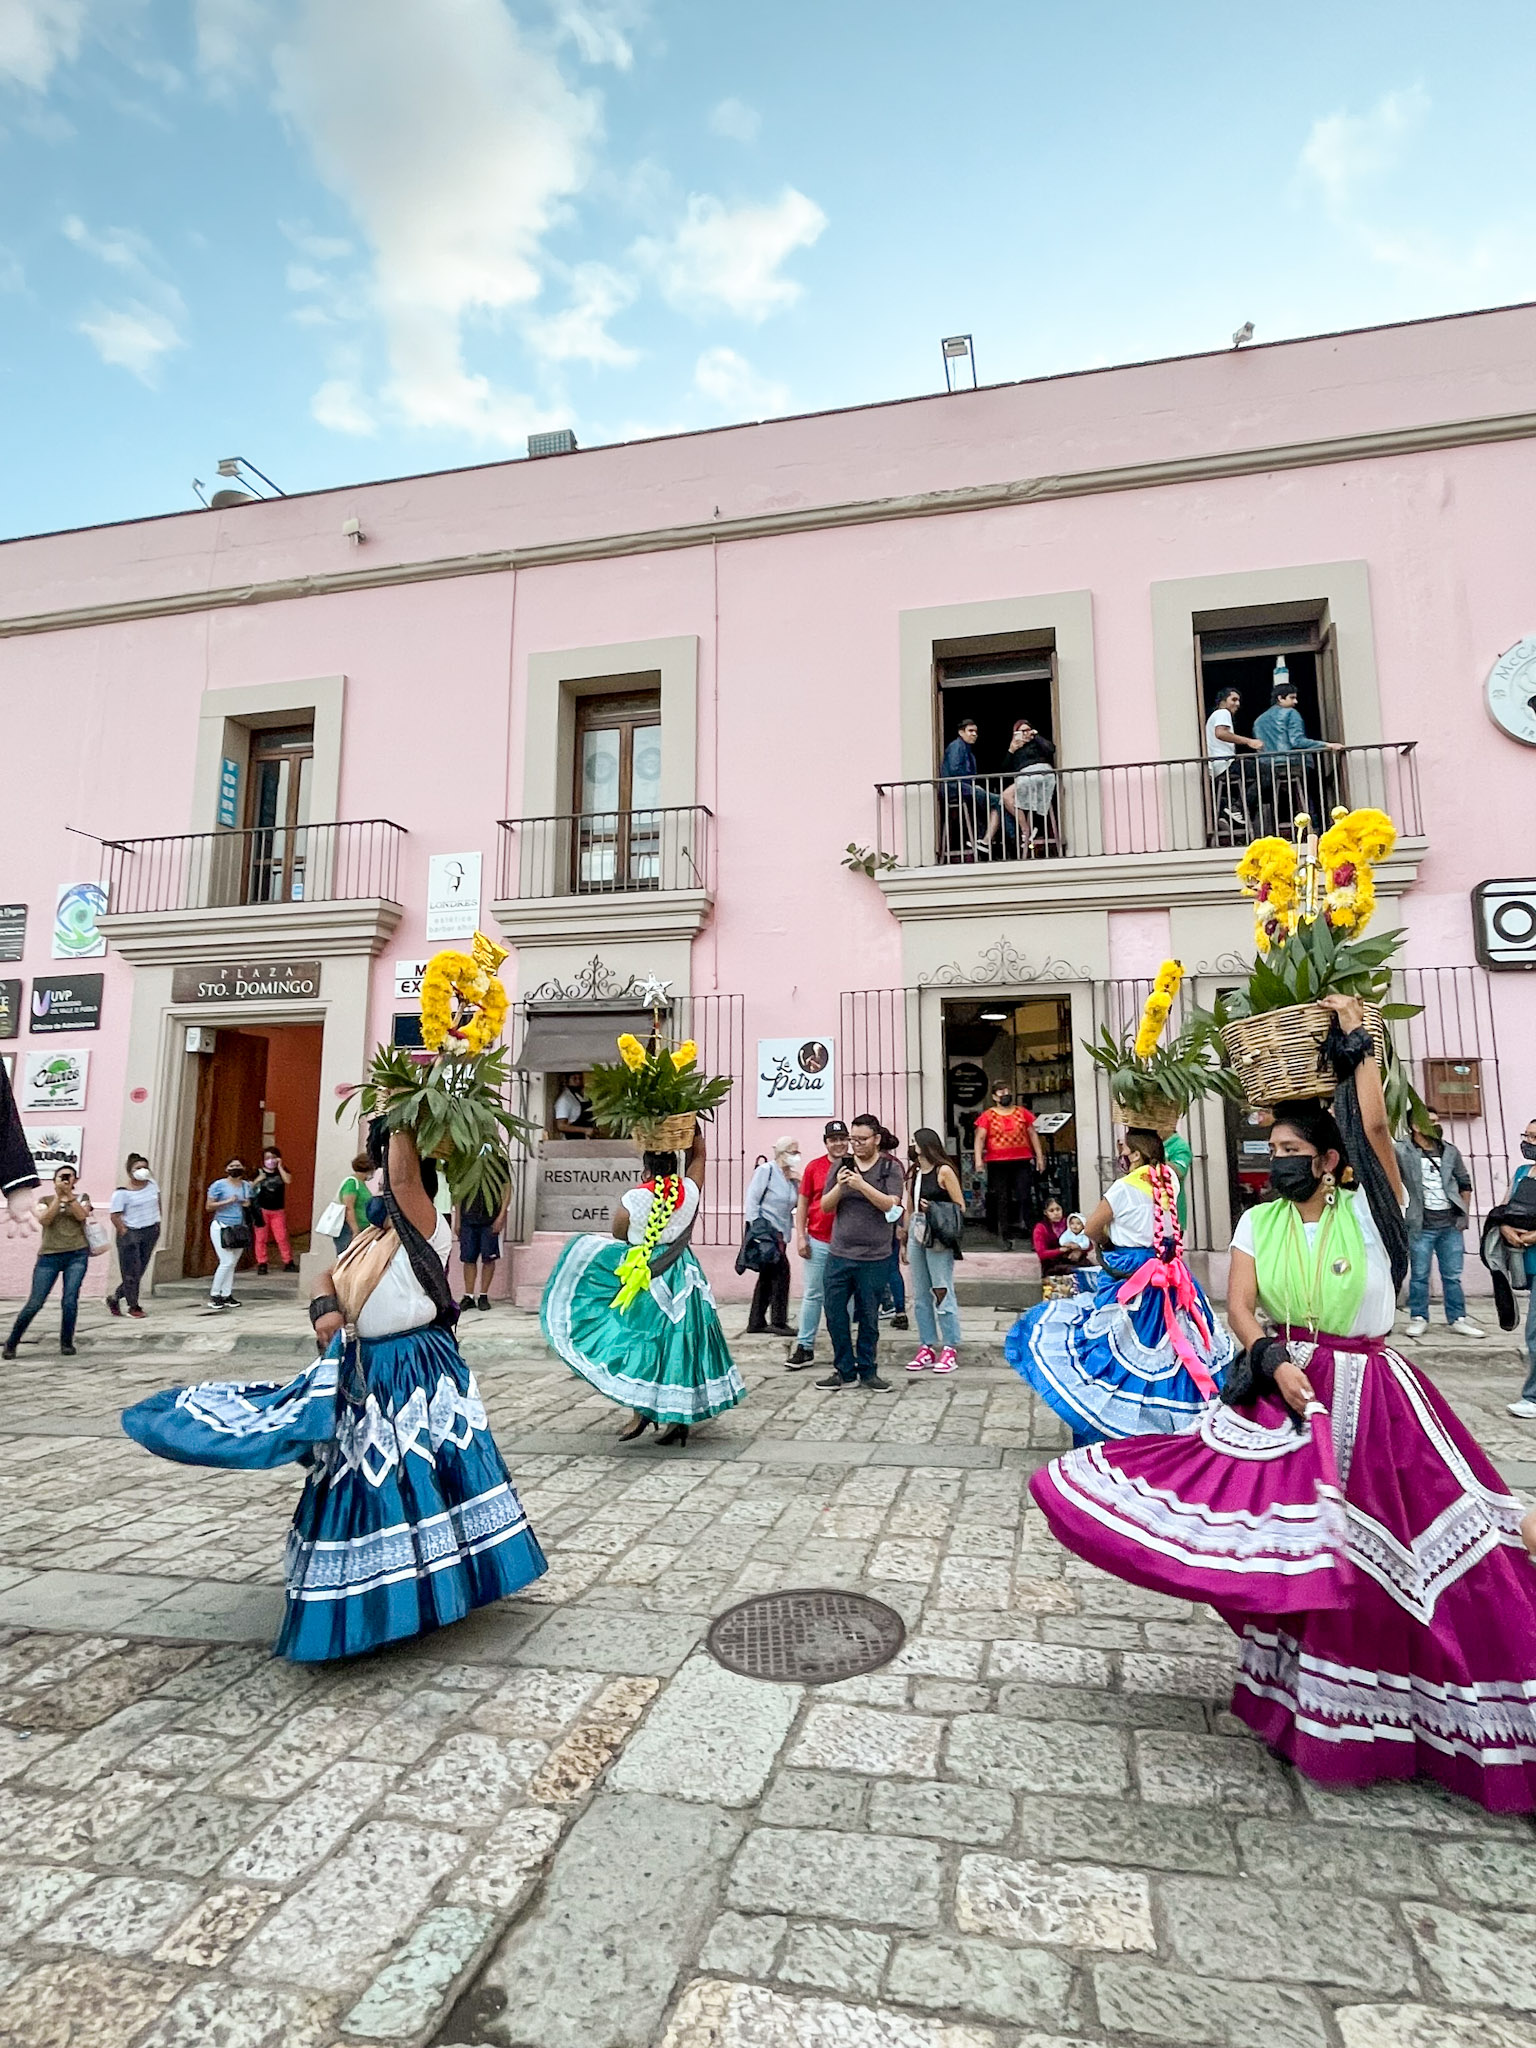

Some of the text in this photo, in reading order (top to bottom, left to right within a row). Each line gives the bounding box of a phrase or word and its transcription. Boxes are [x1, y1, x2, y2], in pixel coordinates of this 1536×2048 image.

[429, 898, 478, 910] LONDRES
[221, 967, 294, 979] PLAZA
[51, 990, 73, 1001] UVP
[198, 980, 313, 997] STO. DOMINGO
[772, 1056, 792, 1073] La
[761, 1072, 824, 1097] Petra
[572, 1205, 610, 1220] CAFÉ
